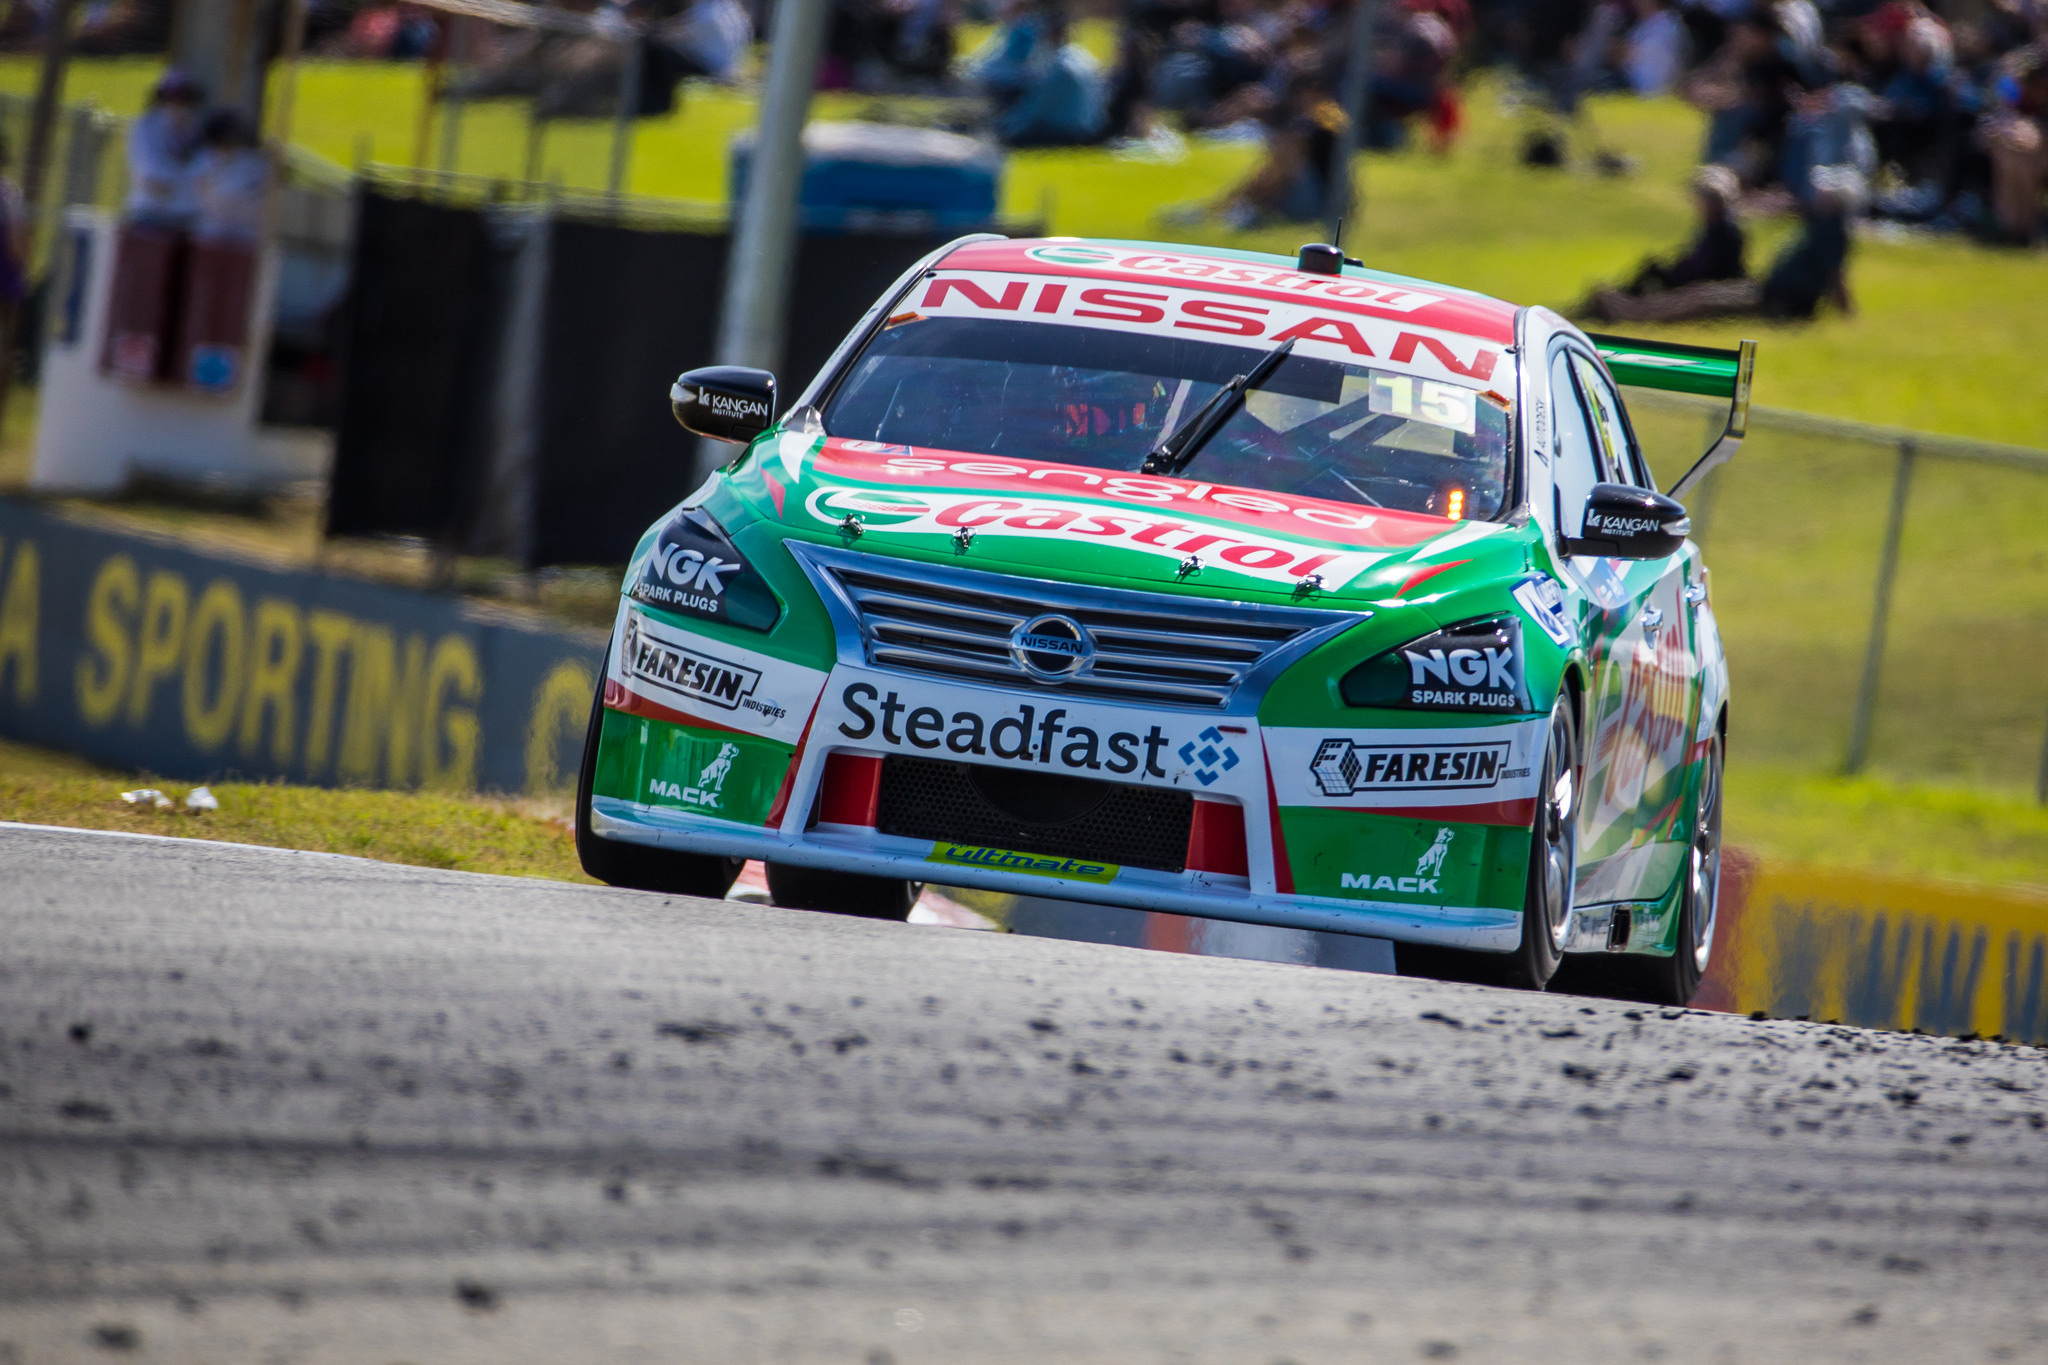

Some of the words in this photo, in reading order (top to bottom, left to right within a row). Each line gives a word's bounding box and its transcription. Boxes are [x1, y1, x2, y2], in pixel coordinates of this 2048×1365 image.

[1118, 254, 1407, 307] Castrol
[920, 278, 1500, 382] NISSAN
[711, 407, 744, 419] INSTITUTE
[712, 394, 768, 416] KANGAN
[1376, 376, 1468, 425] 15
[881, 457, 1378, 530] sengled
[935, 500, 1343, 579] Castrol
[1601, 528, 1635, 537] INSTITUTE
[1602, 516, 1660, 532] KANGAN
[641, 542, 741, 596] NGK
[636, 582, 671, 602] SPARK
[673, 591, 719, 613] PLUGS
[1020, 636, 1084, 654] NISSAN
[75, 552, 484, 795] SPORTING
[636, 642, 744, 702] FARESIN
[1404, 646, 1516, 691] NGK
[1412, 690, 1466, 705] SPARK
[1469, 692, 1516, 708] PLUGS
[837, 682, 1170, 779] Steadfast
[1363, 751, 1500, 783] FARESIN
[649, 778, 720, 808] MACK
[945, 847, 1105, 875] ultimate
[1341, 872, 1439, 894] MACK
